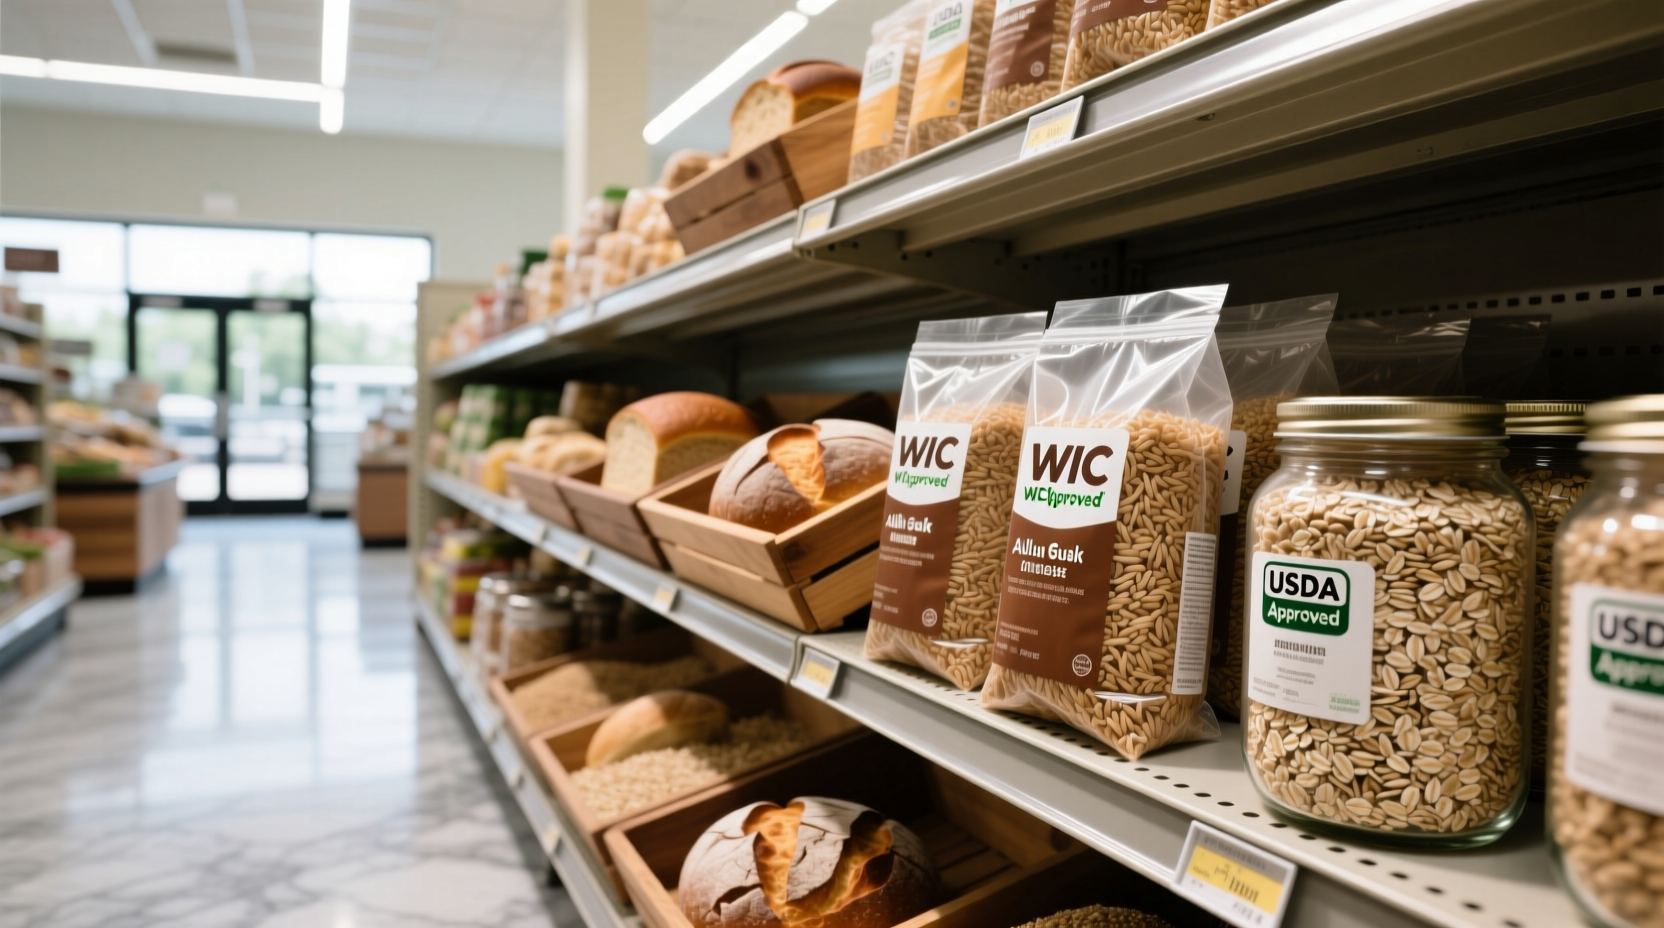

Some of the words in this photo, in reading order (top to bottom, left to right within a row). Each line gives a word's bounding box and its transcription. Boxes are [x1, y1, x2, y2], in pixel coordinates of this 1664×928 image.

[900, 435, 959, 470] WIC
[1032, 444, 1114, 487] WIC
[1269, 570, 1340, 601] USDA
[1267, 601, 1340, 627] Approved
